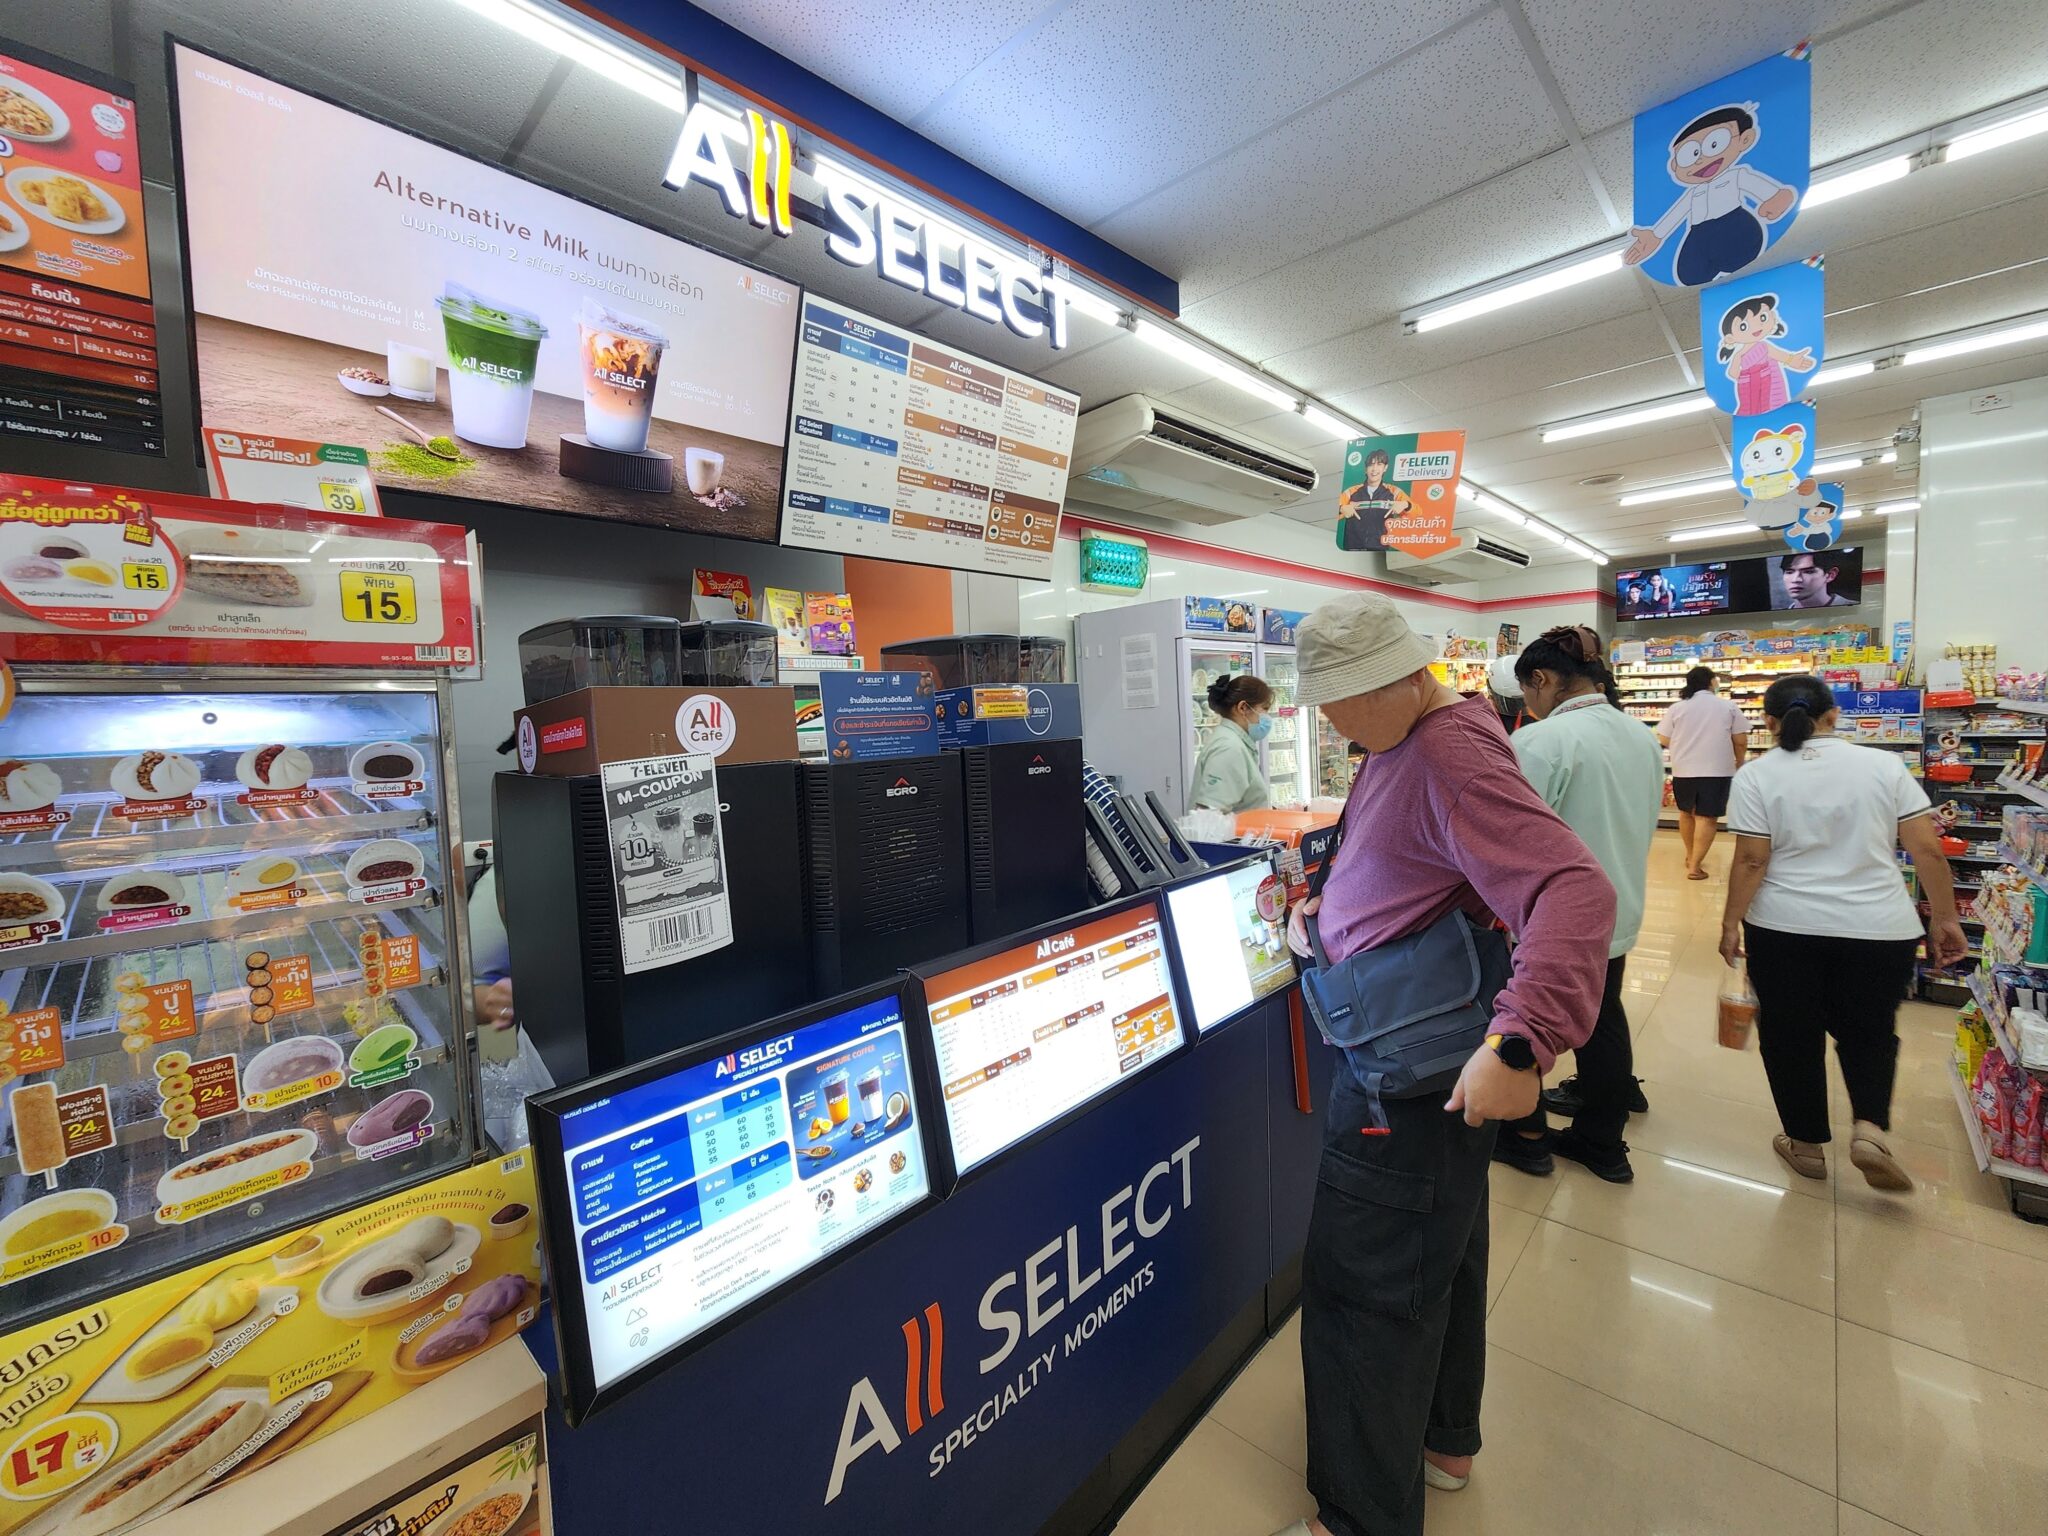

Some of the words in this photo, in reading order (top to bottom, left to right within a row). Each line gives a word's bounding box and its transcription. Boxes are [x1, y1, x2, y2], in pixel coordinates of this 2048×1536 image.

[374, 170, 531, 241] Alternative
[544, 229, 590, 262] Milk
[597, 252, 704, 301] นมทางเลือก
[662, 102, 793, 238] All
[823, 175, 1071, 350] SELECT
[400, 213, 501, 256] นมทางเลือก
[508, 247, 519, 262] 2
[525, 255, 564, 277] สไตล์
[737, 274, 752, 290] All
[753, 281, 792, 305] SELECT
[247, 279, 269, 294] Iced
[272, 285, 318, 305] Pistachio
[320, 295, 340, 311] Milk
[342, 302, 376, 321] Matcha
[378, 311, 402, 326] Latte
[412, 320, 432, 332] 85.-
[414, 309, 425, 321] M
[853, 323, 877, 338] SELECT
[134, 374, 155, 385] 10.-
[461, 356, 476, 371] All
[480, 361, 522, 380] SELECT
[593, 367, 607, 379] All
[609, 372, 646, 389] SELECT
[958, 365, 972, 376] Café
[246, 448, 311, 465] ลดแรง!
[1400, 455, 1449, 468] 7-ELEVEn
[1407, 467, 1448, 478] Delivery
[0, 497, 120, 523] ซื้อคู่ถูกกว่า
[125, 523, 149, 537] SAVE
[1386, 516, 1446, 531] จุดรับสินค้า
[125, 532, 153, 546] MORE
[1381, 530, 1446, 544] บริการรับที่ร้าน
[363, 575, 395, 590] พิเศษ
[356, 590, 412, 622] 15.-
[217, 612, 261, 625] เปาลูกเล็ก
[1657, 647, 1672, 657] สด
[1774, 640, 1793, 650] สด
[690, 701, 722, 730] All
[1033, 707, 1049, 715] SELECT
[523, 722, 532, 747] All
[690, 727, 723, 742] Café
[630, 760, 689, 778] 7-ELEVEn
[1028, 765, 1051, 775] EGRO
[616, 770, 704, 806] M-COUPON
[886, 786, 918, 797] EGRO
[122, 803, 175, 815] บิ๊กเปาหมูสับ
[619, 837, 656, 861] 10.-
[1311, 838, 1327, 855] Pick
[363, 886, 399, 898] เปาถั่วแดง
[116, 911, 159, 924] เปาหมูแดง
[387, 938, 412, 947] ขนมจีบ
[390, 944, 413, 960] หมู
[1035, 938, 1051, 960] All
[1051, 934, 1075, 954] Café
[274, 956, 307, 970] สาหร่าย
[288, 964, 308, 988] กุ้ง
[153, 983, 187, 996] ขนมจีบ
[163, 993, 180, 1015] ปู
[15, 1010, 54, 1026] ขนมจีบ
[20, 1023, 52, 1047] กุ้ง
[197, 1062, 228, 1075] ขนมจีบ
[715, 1054, 736, 1079] All
[739, 1035, 796, 1070] SELECT
[815, 1056, 851, 1075] SIGNATURE
[852, 1044, 876, 1060] COFFEE
[732, 1066, 759, 1082] SPECIALTY
[759, 1057, 784, 1073] MOMENTS
[59, 1093, 103, 1112] ฟองเต้าหู้
[274, 1081, 310, 1100] เปาเผือก
[279, 1094, 298, 1105] Cream
[633, 1154, 661, 1170] Espresso
[704, 1130, 715, 1139] 50
[736, 1116, 747, 1126] 60
[763, 1105, 773, 1114] 70
[635, 1159, 669, 1179] Americano
[706, 1138, 716, 1147] 50
[737, 1125, 747, 1134] 55
[765, 1113, 774, 1122] 65
[580, 1154, 605, 1171] กาแฟ
[630, 1137, 654, 1151] Coffee
[636, 1176, 653, 1188] Latte
[707, 1147, 717, 1156] 55
[739, 1133, 749, 1142] 60
[766, 1121, 775, 1130] 70
[637, 1176, 674, 1197] Cappuccino
[708, 1156, 718, 1165] 55
[740, 1141, 750, 1151] 60
[767, 1129, 776, 1138] 70
[183, 1173, 278, 1212] ซาลองเปาผักเห็ดหอม
[336, 1190, 438, 1237] กลับมาอีกครั้งกับ
[440, 1189, 483, 1200] ซาลาเปา
[486, 1188, 493, 1198] 4
[492, 1186, 506, 1201] ไส้
[643, 1226, 667, 1242] Matcha
[667, 1219, 683, 1231] Latte
[715, 1197, 725, 1206] 60
[746, 1182, 756, 1191] 65
[644, 1237, 667, 1252] Matcha
[667, 1227, 687, 1242] Honey
[686, 1219, 701, 1232] Lime
[747, 1191, 757, 1200] 65
[590, 1220, 640, 1247] ชาเขียวมัทฉะ
[641, 1206, 667, 1223] Matcha
[3, 1264, 40, 1280] Pumpkin
[40, 1255, 68, 1270] Cream
[69, 1249, 84, 1259] Pao
[23, 1240, 83, 1267] เปาฟักทอง
[409, 1270, 450, 1297] เปาถั่วแดง
[602, 1284, 618, 1304] All
[619, 1263, 664, 1293] SELECT
[400, 1313, 433, 1340] เปาเผือก
[824, 1302, 945, 1506] All
[977, 1134, 1201, 1375] SELECT
[208, 1321, 259, 1364] เปาฟักทอง
[214, 1342, 241, 1367] Pumpkin
[242, 1328, 264, 1345] Cream
[262, 1317, 276, 1328] Pao
[276, 1338, 361, 1385] ไส้เห็ดหอม
[929, 1344, 1057, 1478] SPECIALTY
[1064, 1261, 1155, 1358] MOMENTS
[210, 1399, 305, 1473] ซาลองเปาผักเห็ดหอม
[11, 1430, 70, 1488] เจ
